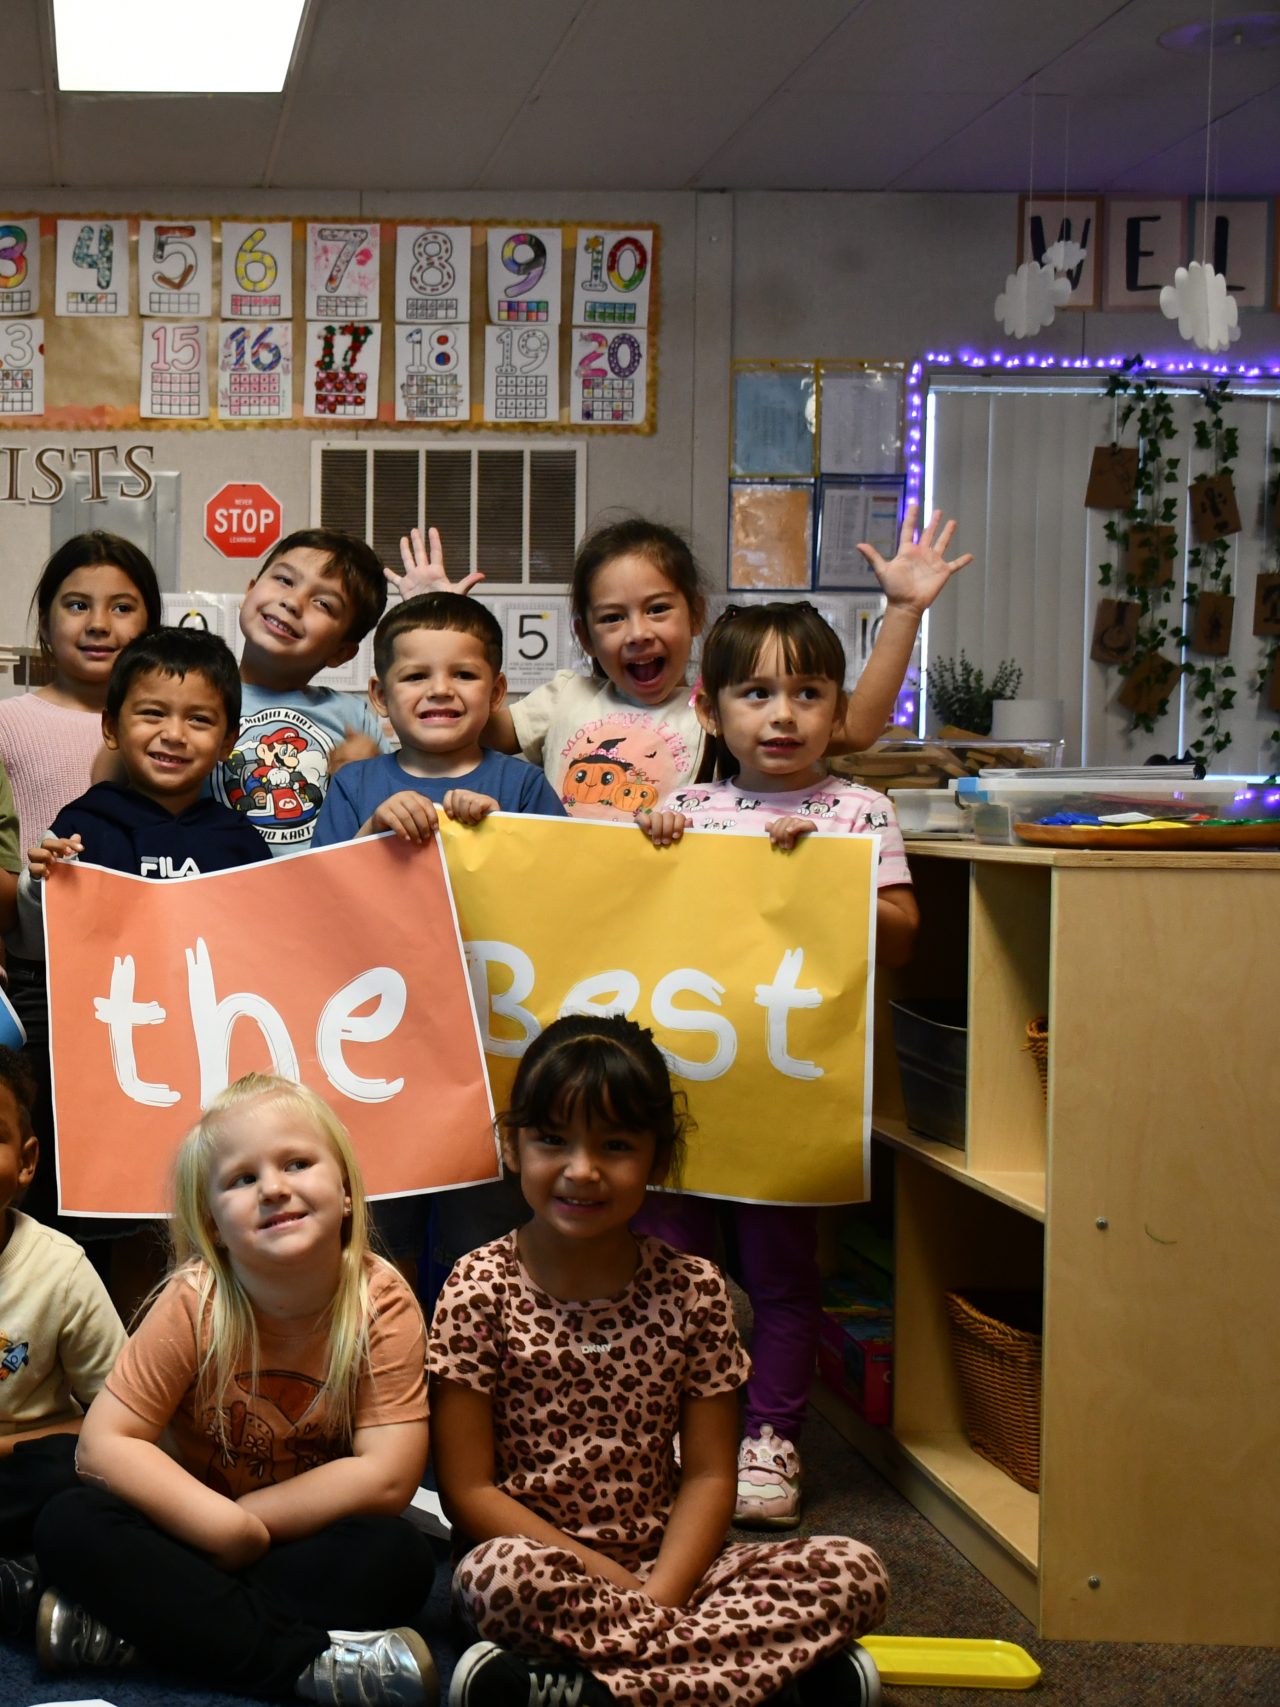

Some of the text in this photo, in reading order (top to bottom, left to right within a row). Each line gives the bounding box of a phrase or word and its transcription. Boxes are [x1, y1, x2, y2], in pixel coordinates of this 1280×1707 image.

[72, 224, 113, 290] 4
[153, 226, 198, 290] 5
[236, 228, 277, 292] 6
[318, 229, 368, 293] 7
[410, 232, 455, 296] 8
[502, 233, 547, 298] 9
[581, 235, 648, 292] 10
[151, 326, 201, 371] 15
[225, 326, 281, 372] 16
[317, 324, 372, 372] 17
[405, 328, 459, 373] 18
[496, 329, 550, 374] 19
[576, 332, 642, 378] 20
[214, 508, 274, 534] STOP
[519, 615, 548, 660] 5
[245, 711, 313, 730] MARIO KART
[281, 826, 311, 841] KART
[141, 856, 200, 877] FILA
[93, 937, 407, 1111] the
[581, 1343, 612, 1354] DKNY
